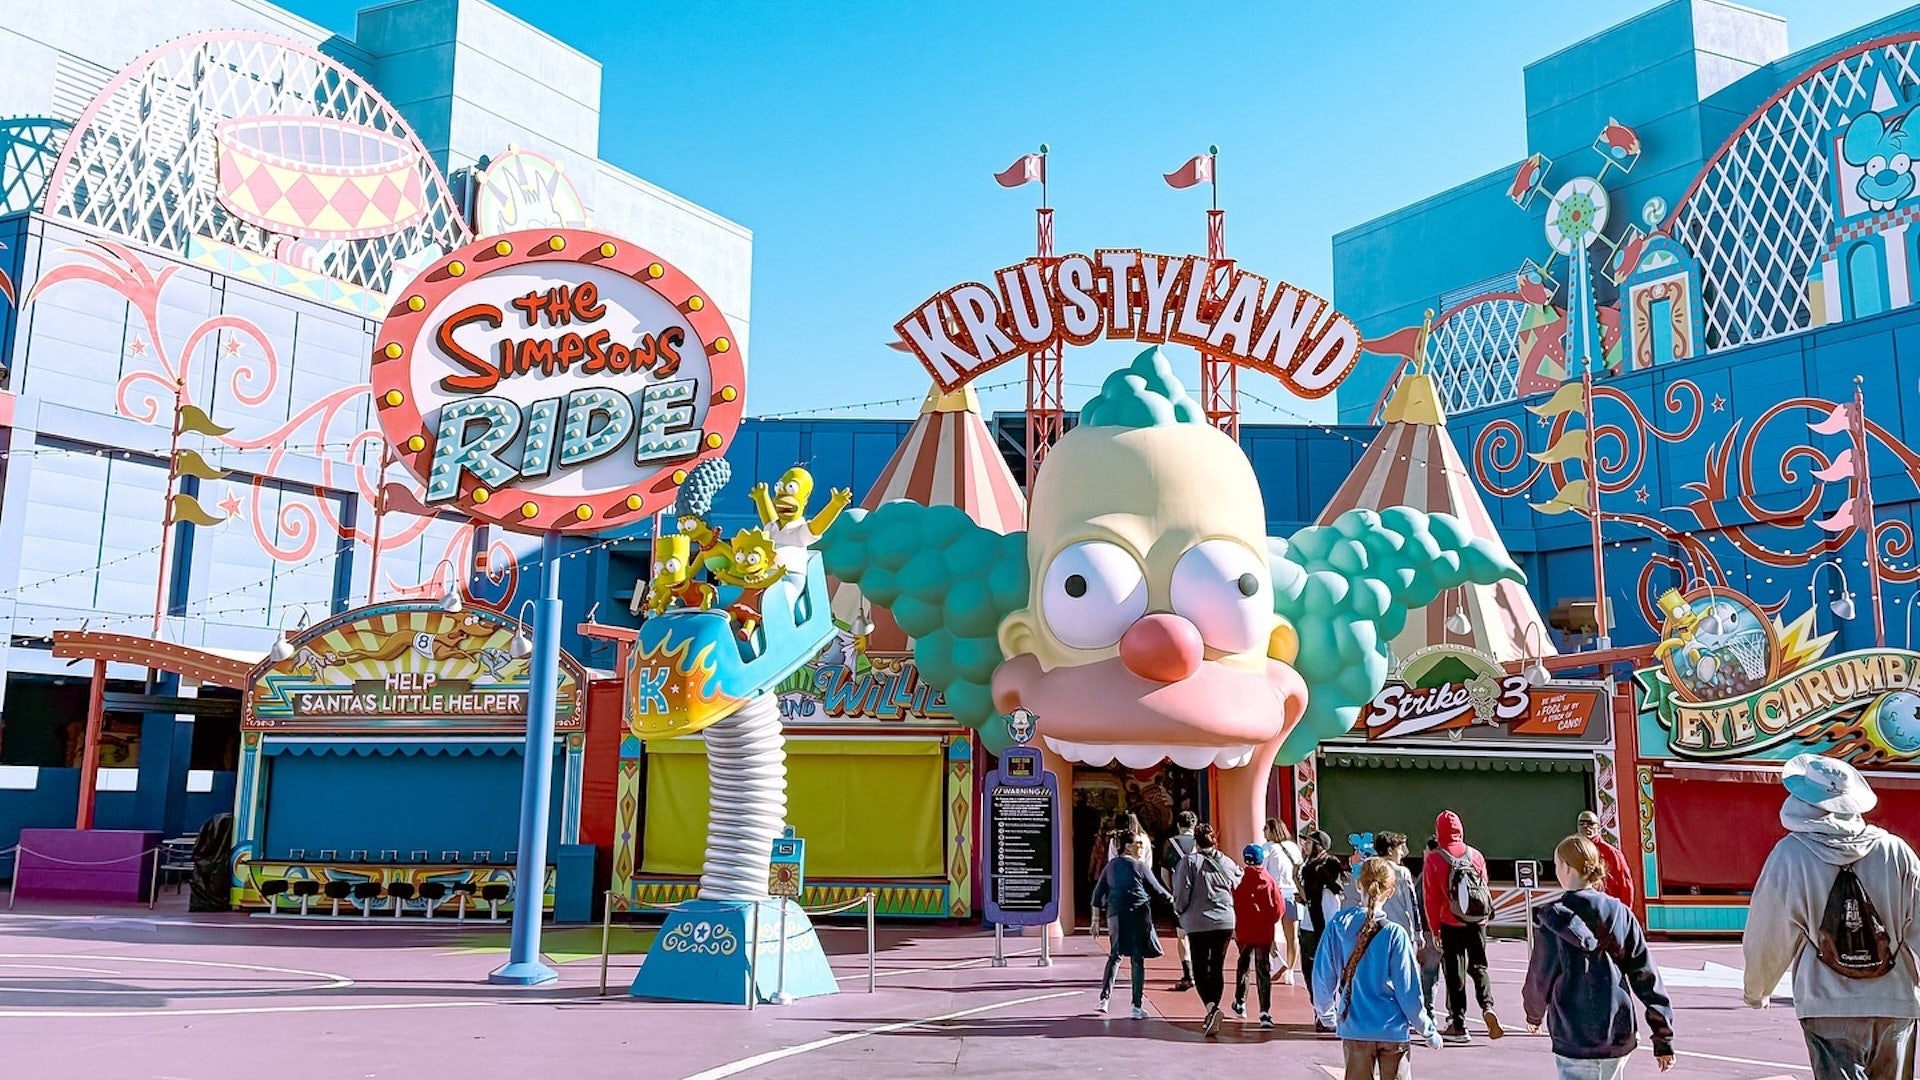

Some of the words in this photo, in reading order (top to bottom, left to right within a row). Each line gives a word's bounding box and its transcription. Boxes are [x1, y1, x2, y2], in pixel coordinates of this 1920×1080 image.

[900, 251, 1359, 390] KRUSTYLAND
[436, 303, 685, 393] SIMPSONS
[425, 379, 703, 505] RIDE
[418, 635, 429, 648] 8
[300, 694, 377, 714] SANTA'S
[382, 694, 444, 714] LITTLE
[448, 693, 521, 713] HELPER
[385, 672, 437, 692] HELP
[639, 667, 670, 715] K
[1366, 681, 1472, 728] Strike
[1496, 677, 1530, 719] 3
[1541, 703, 1561, 716] FOOL
[1557, 716, 1582, 730] CANS!
[1676, 701, 1757, 749] EYE
